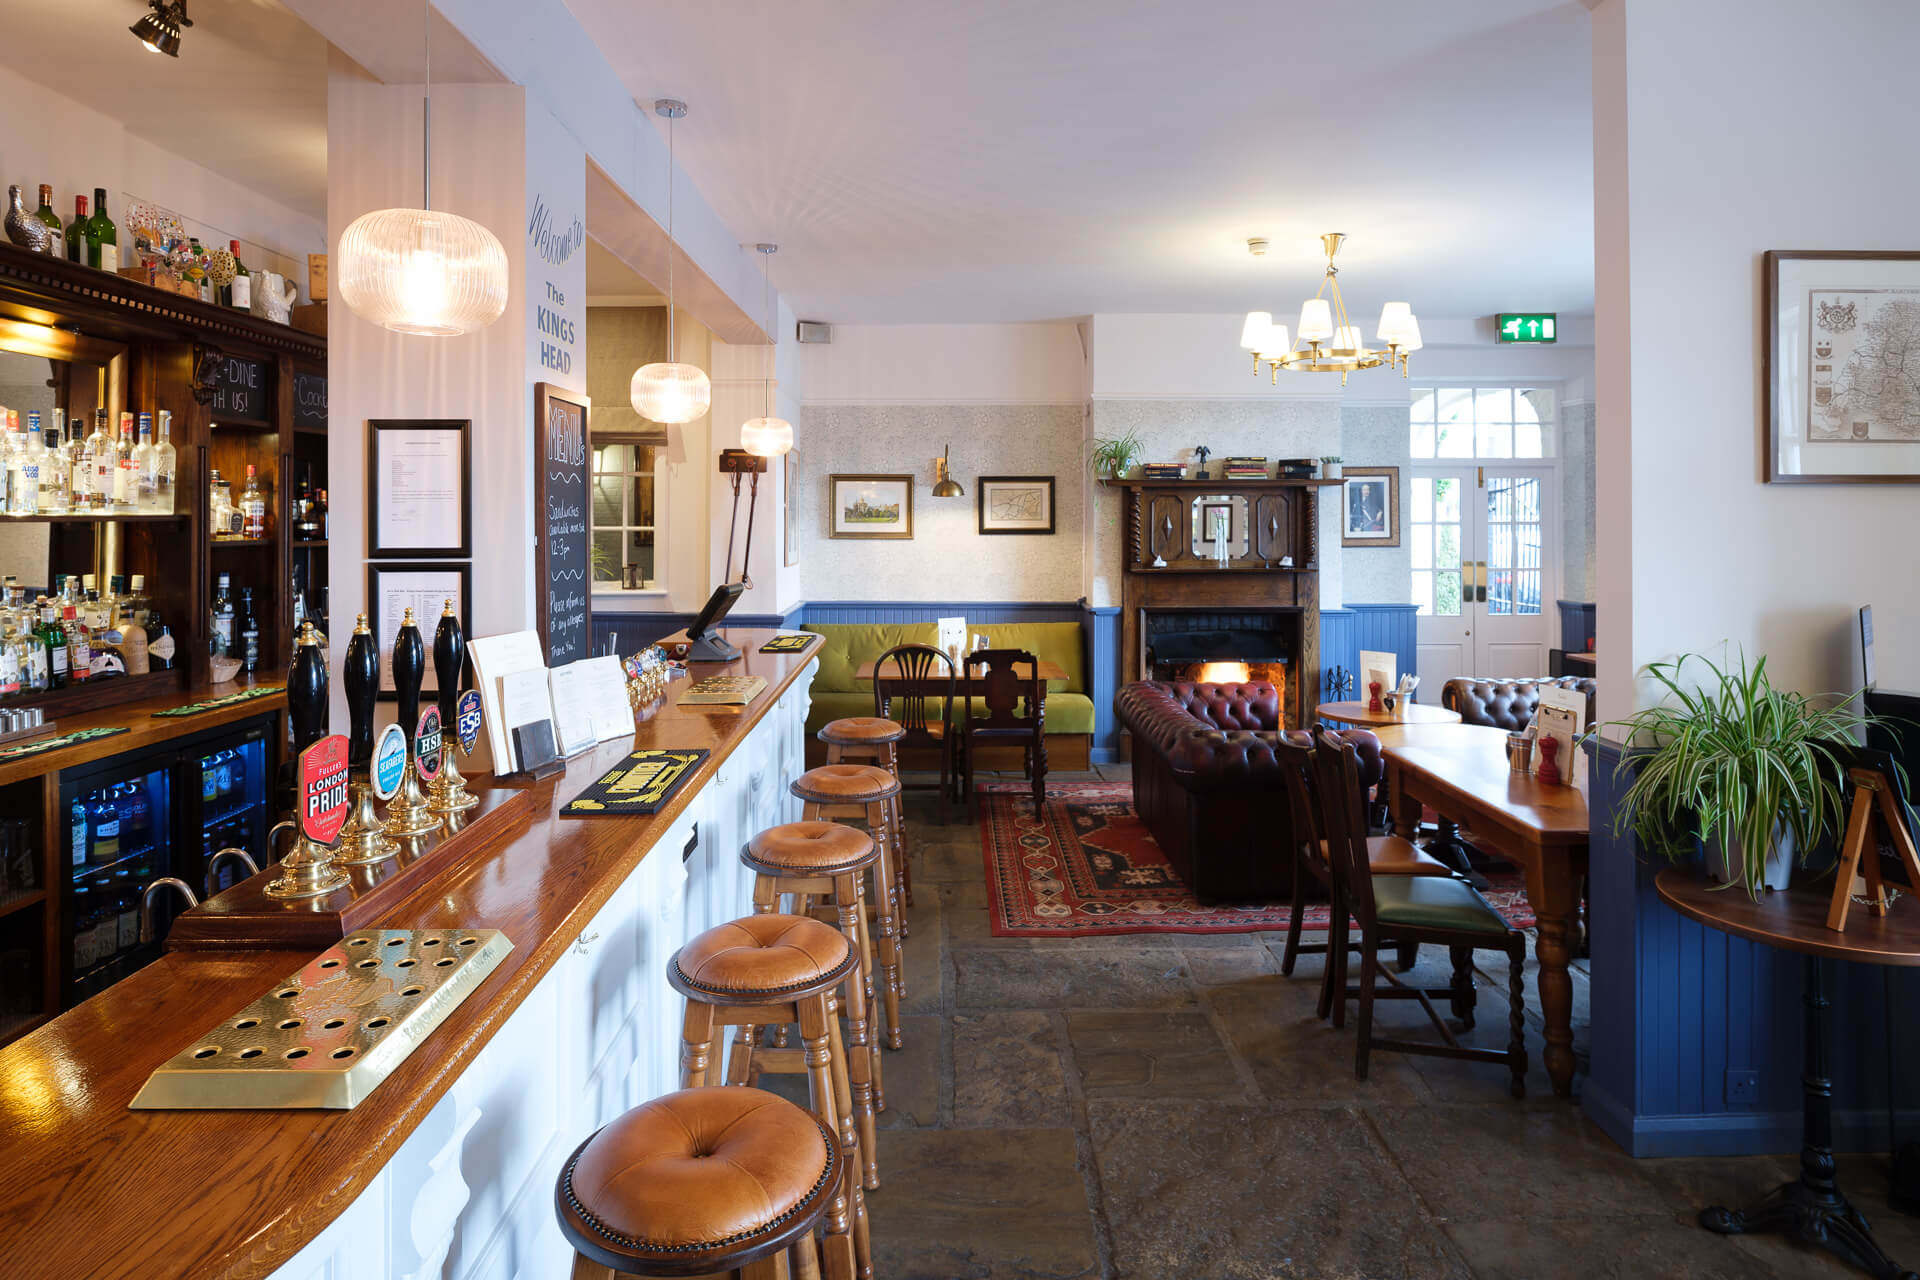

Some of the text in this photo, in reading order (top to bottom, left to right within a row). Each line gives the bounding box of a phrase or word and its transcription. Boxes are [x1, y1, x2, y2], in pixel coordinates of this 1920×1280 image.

[529, 193, 583, 265] Welcome to
[545, 281, 565, 306] The
[537, 304, 575, 345] KINGS
[541, 341, 571, 376] HEAD
[460, 711, 481, 735] ESB
[308, 767, 348, 794] LONDON
[308, 781, 348, 819] PRIDE
